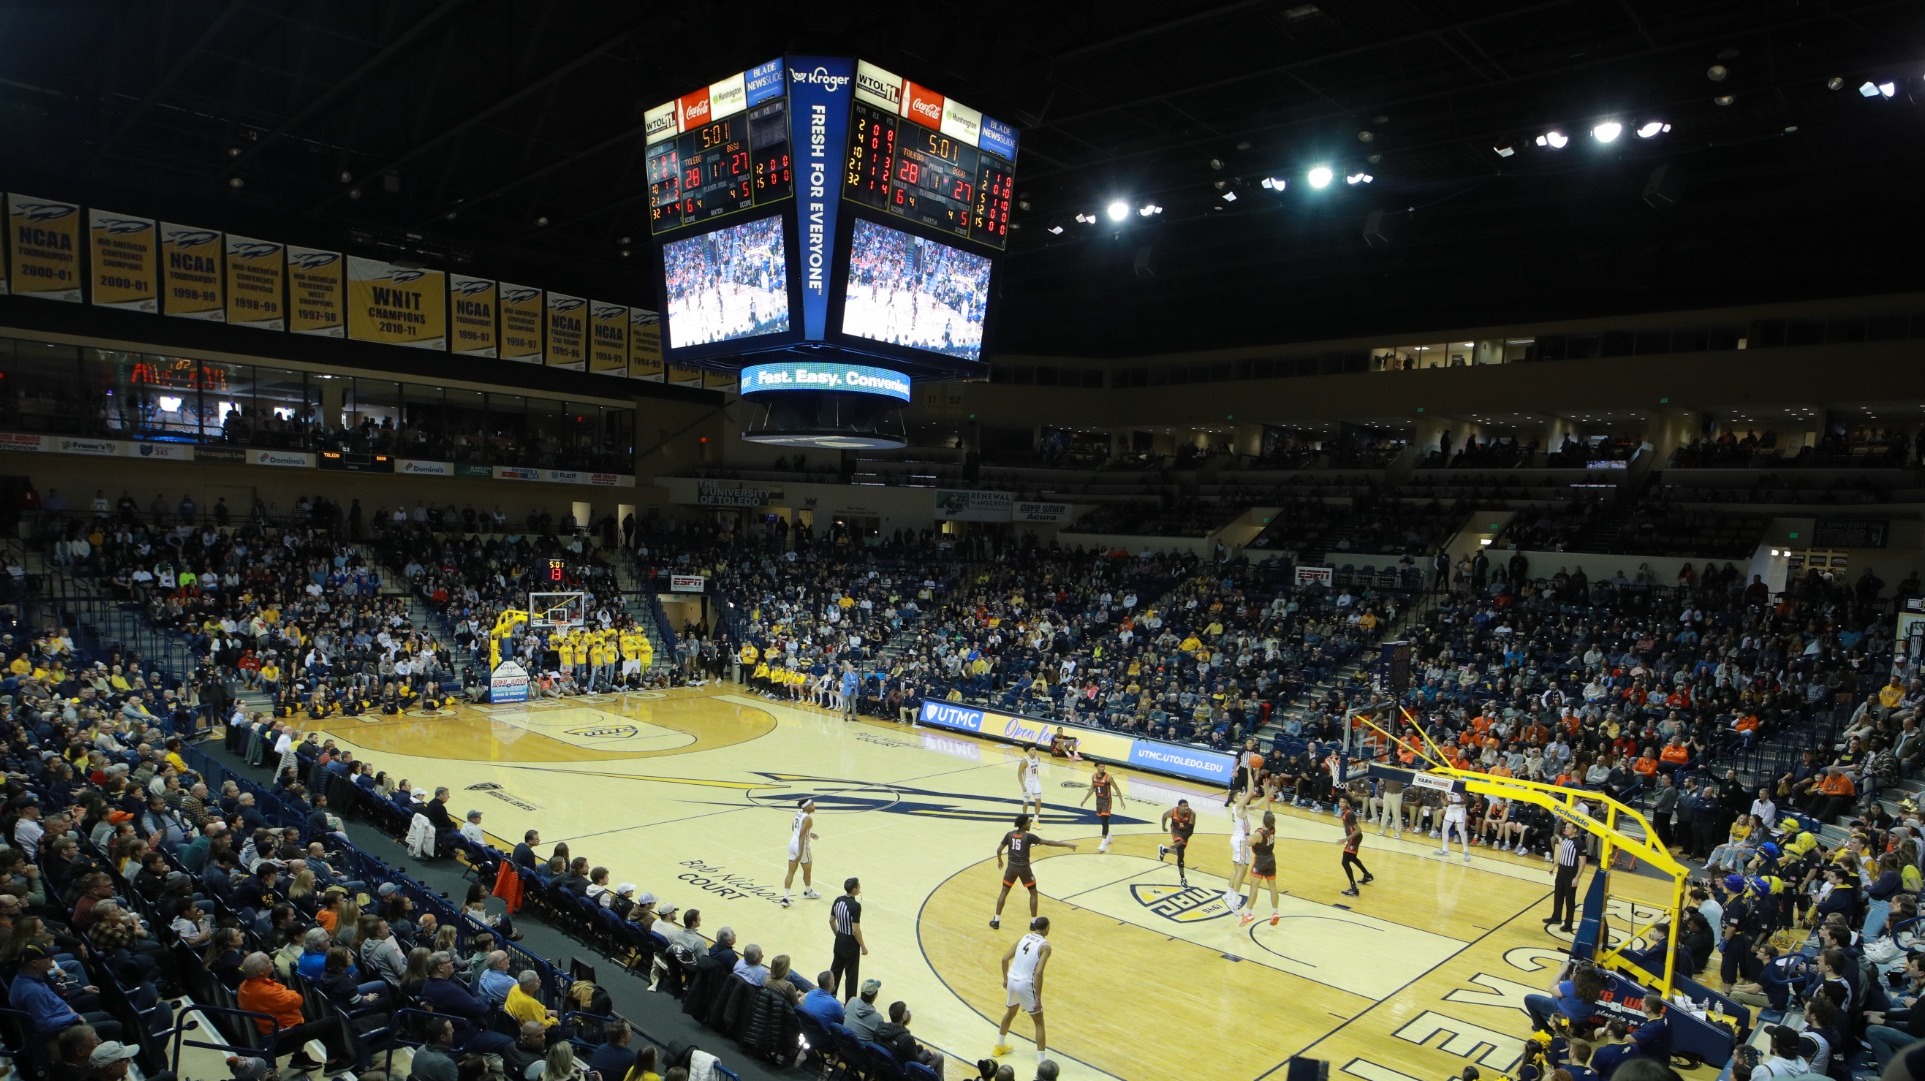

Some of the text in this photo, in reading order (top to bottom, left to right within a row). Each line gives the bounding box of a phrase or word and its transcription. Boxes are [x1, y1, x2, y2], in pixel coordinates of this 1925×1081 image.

[753, 63, 776, 77] BLADE
[808, 66, 849, 92] Kroger
[859, 74, 885, 92] WTOL
[912, 98, 941, 120] Coca-Cola
[646, 118, 665, 131] WTOL
[859, 118, 866, 130] 2
[952, 112, 977, 129] Huntington
[873, 124, 880, 136] 0
[990, 121, 1011, 136] BLADE
[702, 123, 728, 148] 5:01
[887, 130, 893, 141] 8
[854, 146, 862, 158] 10
[929, 135, 958, 161] 5:01
[732, 152, 749, 174] 27
[756, 163, 764, 174] 12
[849, 158, 861, 170] 21
[928, 163, 943, 173] PERIOD
[872, 167, 875, 176] 1
[883, 170, 889, 182] 2
[900, 160, 918, 184] 28
[685, 167, 700, 189] 28
[757, 177, 764, 188] 15
[848, 172, 859, 186] 32
[934, 175, 939, 187] 1
[742, 181, 749, 197] 5
[869, 180, 874, 190] 1
[881, 184, 888, 194] 4
[954, 180, 972, 202] 27
[809, 105, 825, 290] FRESH FOR EVERYONE
[896, 189, 904, 204] 6
[1003, 188, 1010, 199] 10
[686, 198, 693, 213] 6
[977, 204, 984, 214] 12
[1001, 201, 1008, 211] 10
[961, 211, 967, 226] 5
[990, 208, 995, 219] 0
[1002, 212, 1006, 222] 0
[975, 217, 982, 227] 15
[989, 221, 994, 231] 0
[1000, 225, 1005, 235] 0
[19, 226, 72, 251] NCAA
[97, 237, 147, 252] MID-AMERICAN
[18, 247, 73, 262] TOURNAMENT
[102, 249, 143, 261] CONFERENCE
[103, 259, 143, 271] CHAMPIONS
[170, 252, 215, 273] NCAA
[21, 264, 72, 281] 2000-01
[232, 263, 279, 276] MID-AMERICAN
[100, 275, 148, 291] 2000-01
[169, 271, 216, 284] TOURNAMENT
[236, 273, 274, 285] CONFERENCE
[293, 273, 338, 284] MID-AMERICAN
[237, 282, 274, 294] CHAMPIONS
[298, 282, 334, 292] CONFERENCE
[173, 288, 216, 301] 1998-99
[372, 286, 422, 311] WNIT
[235, 298, 277, 312] 1998-99
[299, 298, 334, 308] CHAMPIONS
[456, 300, 490, 318] NCAA
[298, 309, 337, 322] 1997-98
[368, 306, 426, 324] CHAMPIONS
[504, 307, 539, 318] MID-AMERICAN
[456, 316, 491, 327] TOURNAMENT
[552, 315, 581, 332] NCAA
[379, 322, 417, 336] 2010-11
[507, 324, 535, 332] CHAMPIONS
[595, 324, 623, 341] NCAA
[459, 330, 490, 342] 1996-97
[551, 329, 582, 340] TOURNAMENT
[633, 330, 661, 340] MID-AMERICA
[506, 337, 537, 349] 1996-97
[594, 340, 624, 350] TOURNAMENT
[552, 346, 580, 358] 1995-96
[595, 351, 622, 363] 1994-95
[634, 356, 661, 368] 1994-95
[758, 371, 792, 385] Fast.
[796, 369, 842, 387] Easy.
[270, 457, 305, 465] Domino's
[699, 479, 719, 487] THE
[710, 488, 771, 498] UNIVERSITY
[971, 492, 1010, 500] RENEWAL
[700, 496, 760, 506] OF TOLEDO
[1026, 513, 1057, 521] Acura
[549, 560, 564, 569] 5:01
[551, 569, 561, 580] 13
[1298, 569, 1330, 580] ESPN
[673, 577, 702, 586] ESPN
[937, 706, 980, 728] UTMC
[1005, 718, 1037, 740] Open
[1138, 749, 1224, 773] UTMC.UTOLEDO.EDU
[1554, 804, 1589, 827] Schelde
[1011, 838, 1021, 851] 15
[679, 859, 726, 873] Bob
[677, 873, 749, 900] COURT
[1022, 941, 1031, 955] 4
